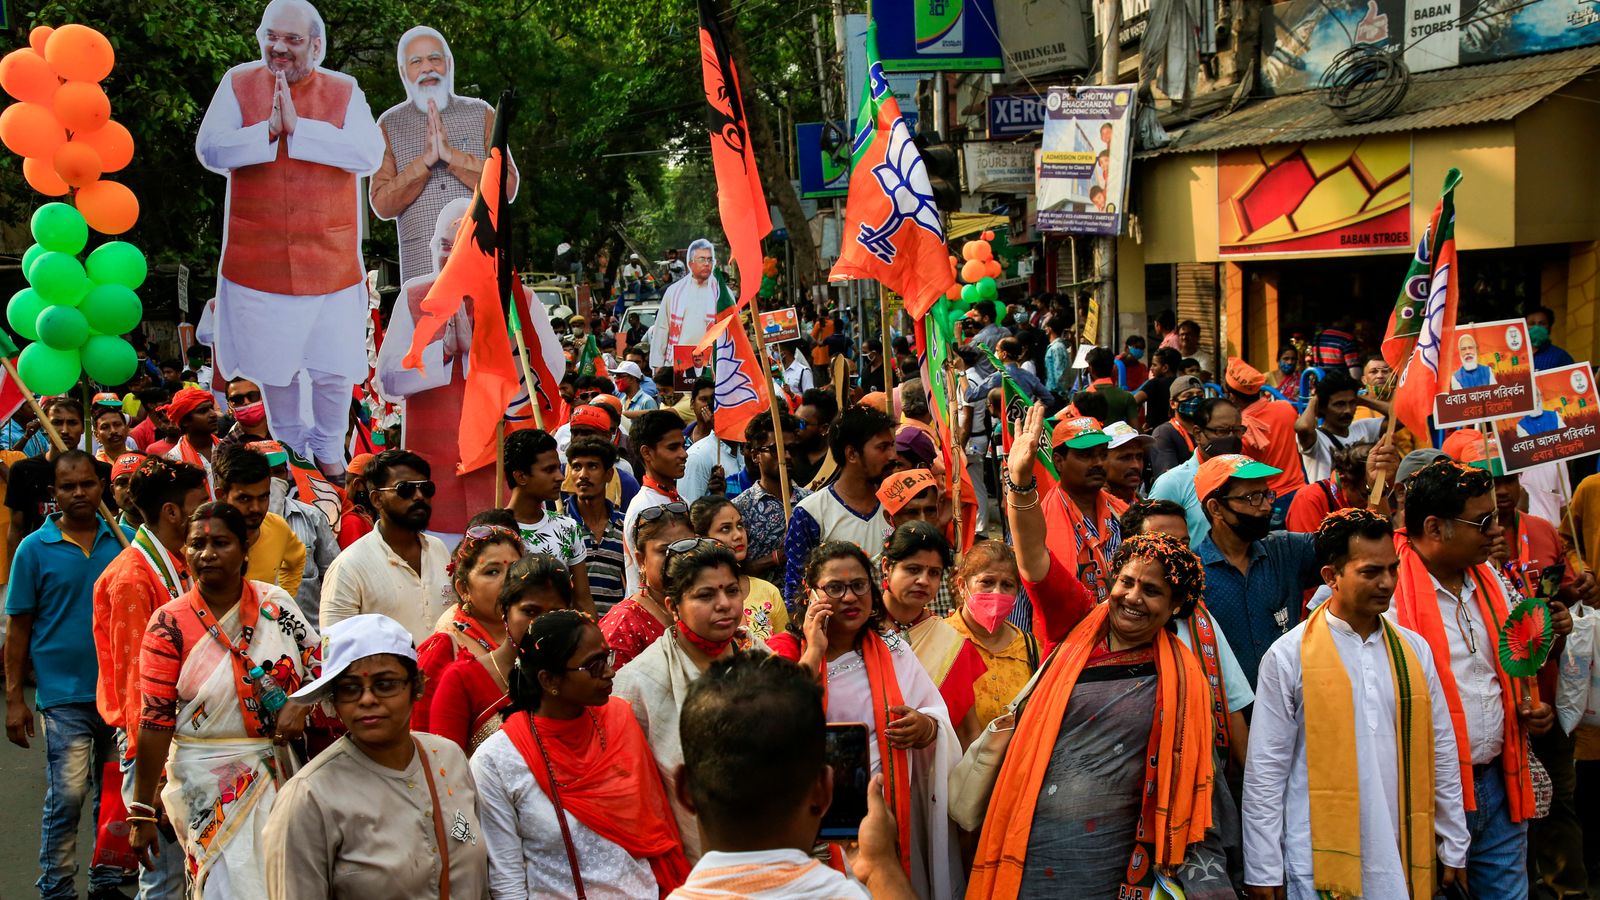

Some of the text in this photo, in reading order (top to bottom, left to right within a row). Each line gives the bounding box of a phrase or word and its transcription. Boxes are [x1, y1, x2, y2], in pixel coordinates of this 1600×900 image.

[1414, 5, 1451, 20] BABAN
[1411, 20, 1453, 37] STORES
[1007, 42, 1067, 64] SHRINGAR
[995, 100, 1046, 124] XERO
[977, 156, 1008, 169] TOURS
[1340, 231, 1409, 245] BABAN STROES
[1445, 382, 1525, 406] এবার আসল পরিবর্তন
[1463, 405, 1483, 417] এবার
[1511, 423, 1596, 453] এবার আসল পরিবর্তন
[1531, 449, 1554, 462] এবার
